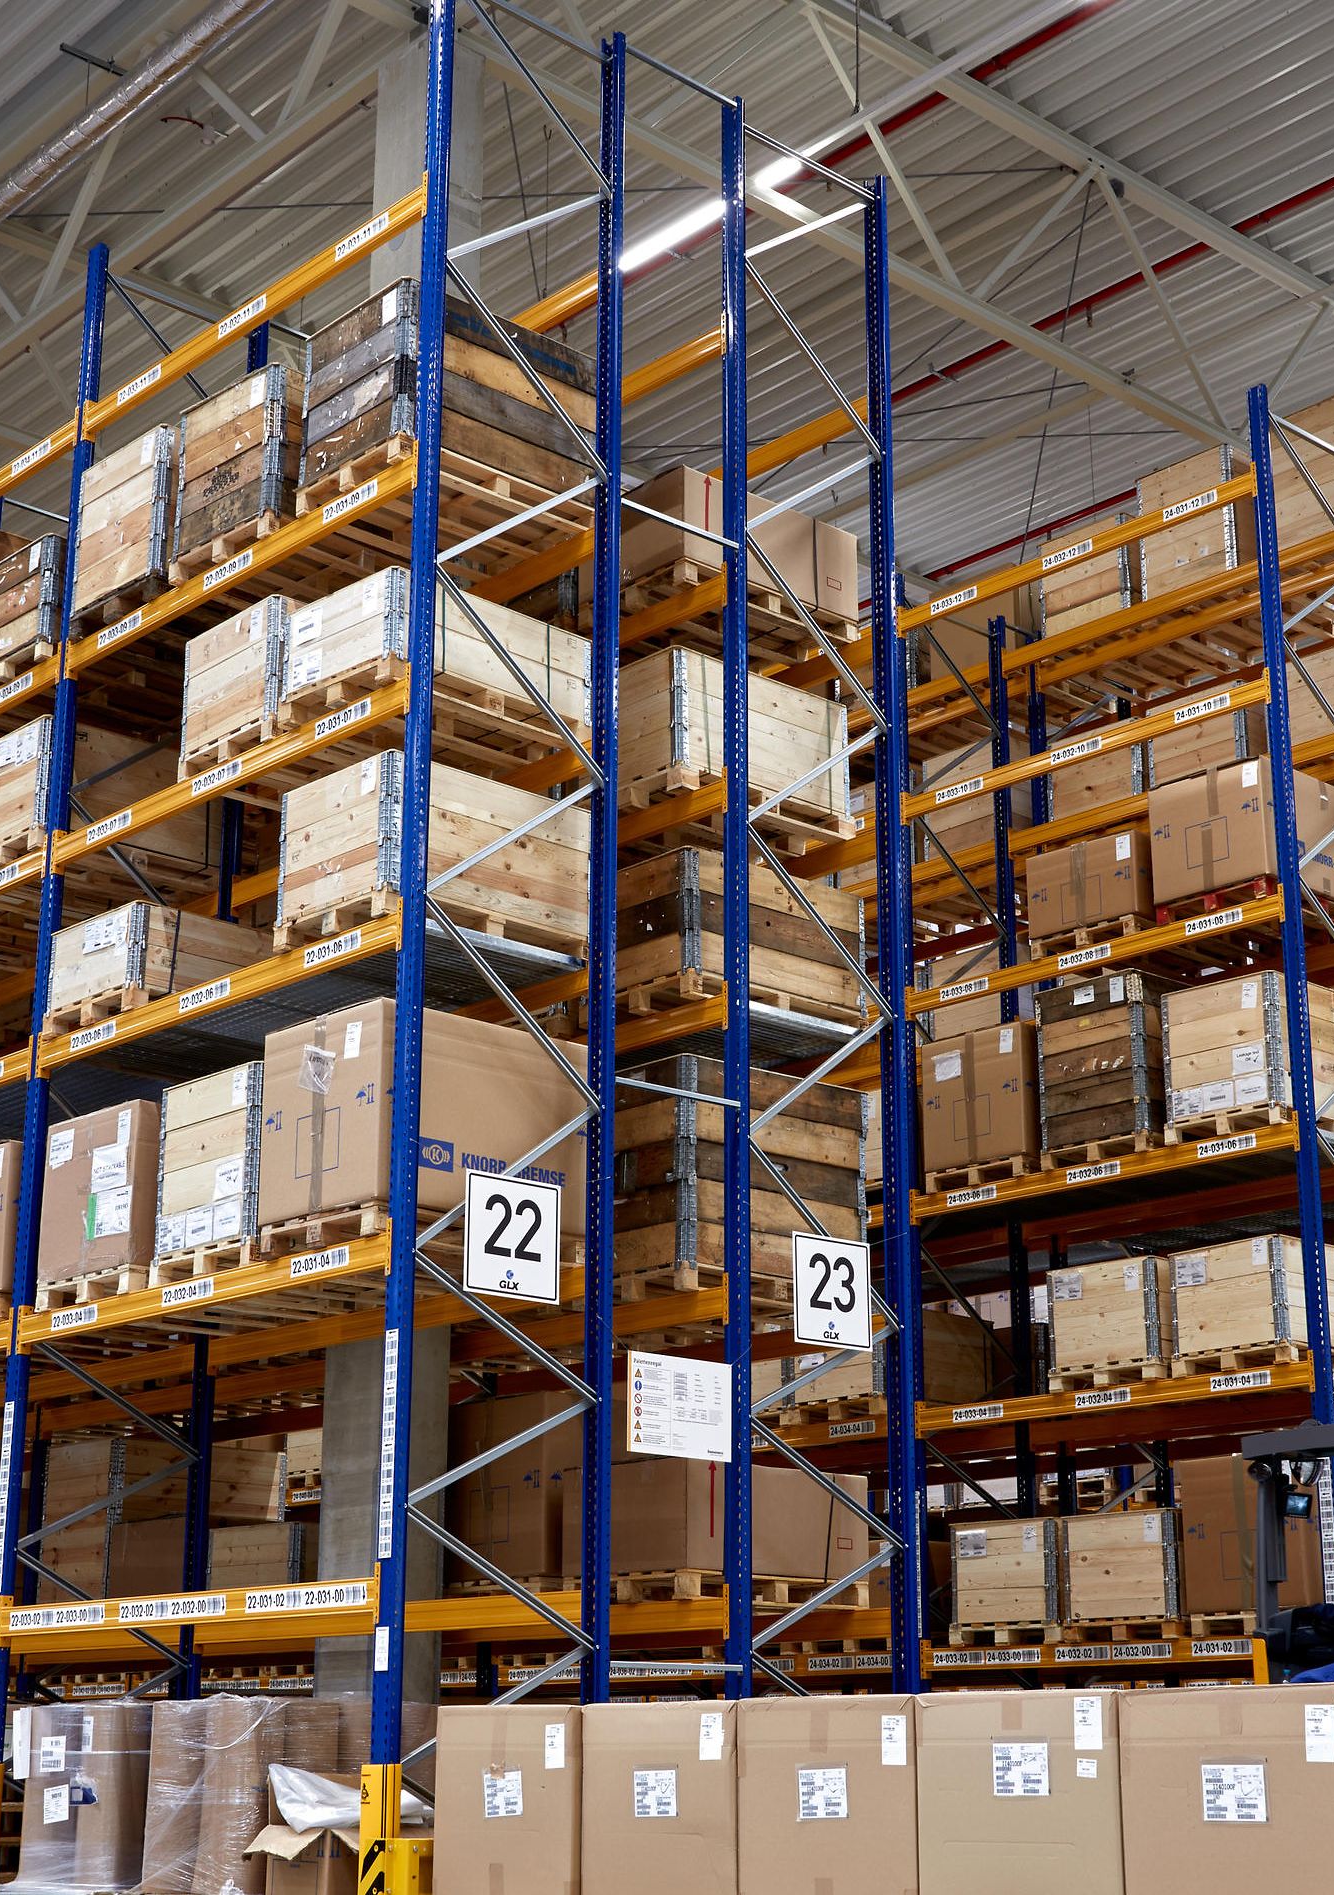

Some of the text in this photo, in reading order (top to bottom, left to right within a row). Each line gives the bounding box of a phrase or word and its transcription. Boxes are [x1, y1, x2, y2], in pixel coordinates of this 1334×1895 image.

[336, 226, 371, 258] 22-031-11
[324, 492, 360, 520] 22-031-09
[1164, 498, 1200, 520] 24-031-12
[1043, 547, 1077, 568] 24-032-12
[204, 561, 238, 588] 22-032-09
[931, 593, 963, 613] 24-033-12
[1175, 701, 1212, 722] 24-031-10
[316, 709, 353, 736] 22-031-07
[1051, 743, 1086, 762] 24-032-10
[193, 768, 226, 793] 22-032-07
[936, 784, 969, 802] 24-033-10
[88, 819, 118, 842] 22-033-07
[1187, 915, 1224, 934] 24-031-08
[305, 940, 343, 964] 22-031-06
[1058, 950, 1094, 968] 24-032-08
[180, 987, 215, 1011] 22-032-06
[940, 983, 973, 1000] 24-033-08
[71, 1028, 102, 1050] 22-033-06
[1198, 1139, 1237, 1156] 24-031-06
[461, 1152, 566, 1187] KNORRREMSE
[1068, 1165, 1104, 1182] 24-032-06
[948, 1189, 981, 1205] 24-033-06
[484, 1193, 542, 1263] 22
[292, 1254, 330, 1275] 22-031-04
[499, 1279, 520, 1291] GLX
[809, 1253, 856, 1313] 23
[163, 1285, 198, 1304] 22-032-04
[52, 1309, 83, 1328] 22-033-04
[823, 1331, 840, 1341] GLX
[1212, 1374, 1252, 1389] 24-031-04
[1076, 1391, 1113, 1407] 24-032-04
[954, 1408, 988, 1422] 24-033-04
[829, 1424, 861, 1437] 24-034-04
[247, 1589, 345, 1610] 22-031-02 22-031-00
[10, 1609, 88, 1627] 22-033-02 22-033-00
[120, 1600, 207, 1619] 22-032-02 22-032-00
[934, 1651, 1021, 1664] 24-033-02 24-033-00
[1056, 1646, 1151, 1660] 24-032-02 24-032-00
[1193, 1642, 1233, 1654] 24-031-02
[809, 1656, 889, 1669] 24-034-02 24-034-00
